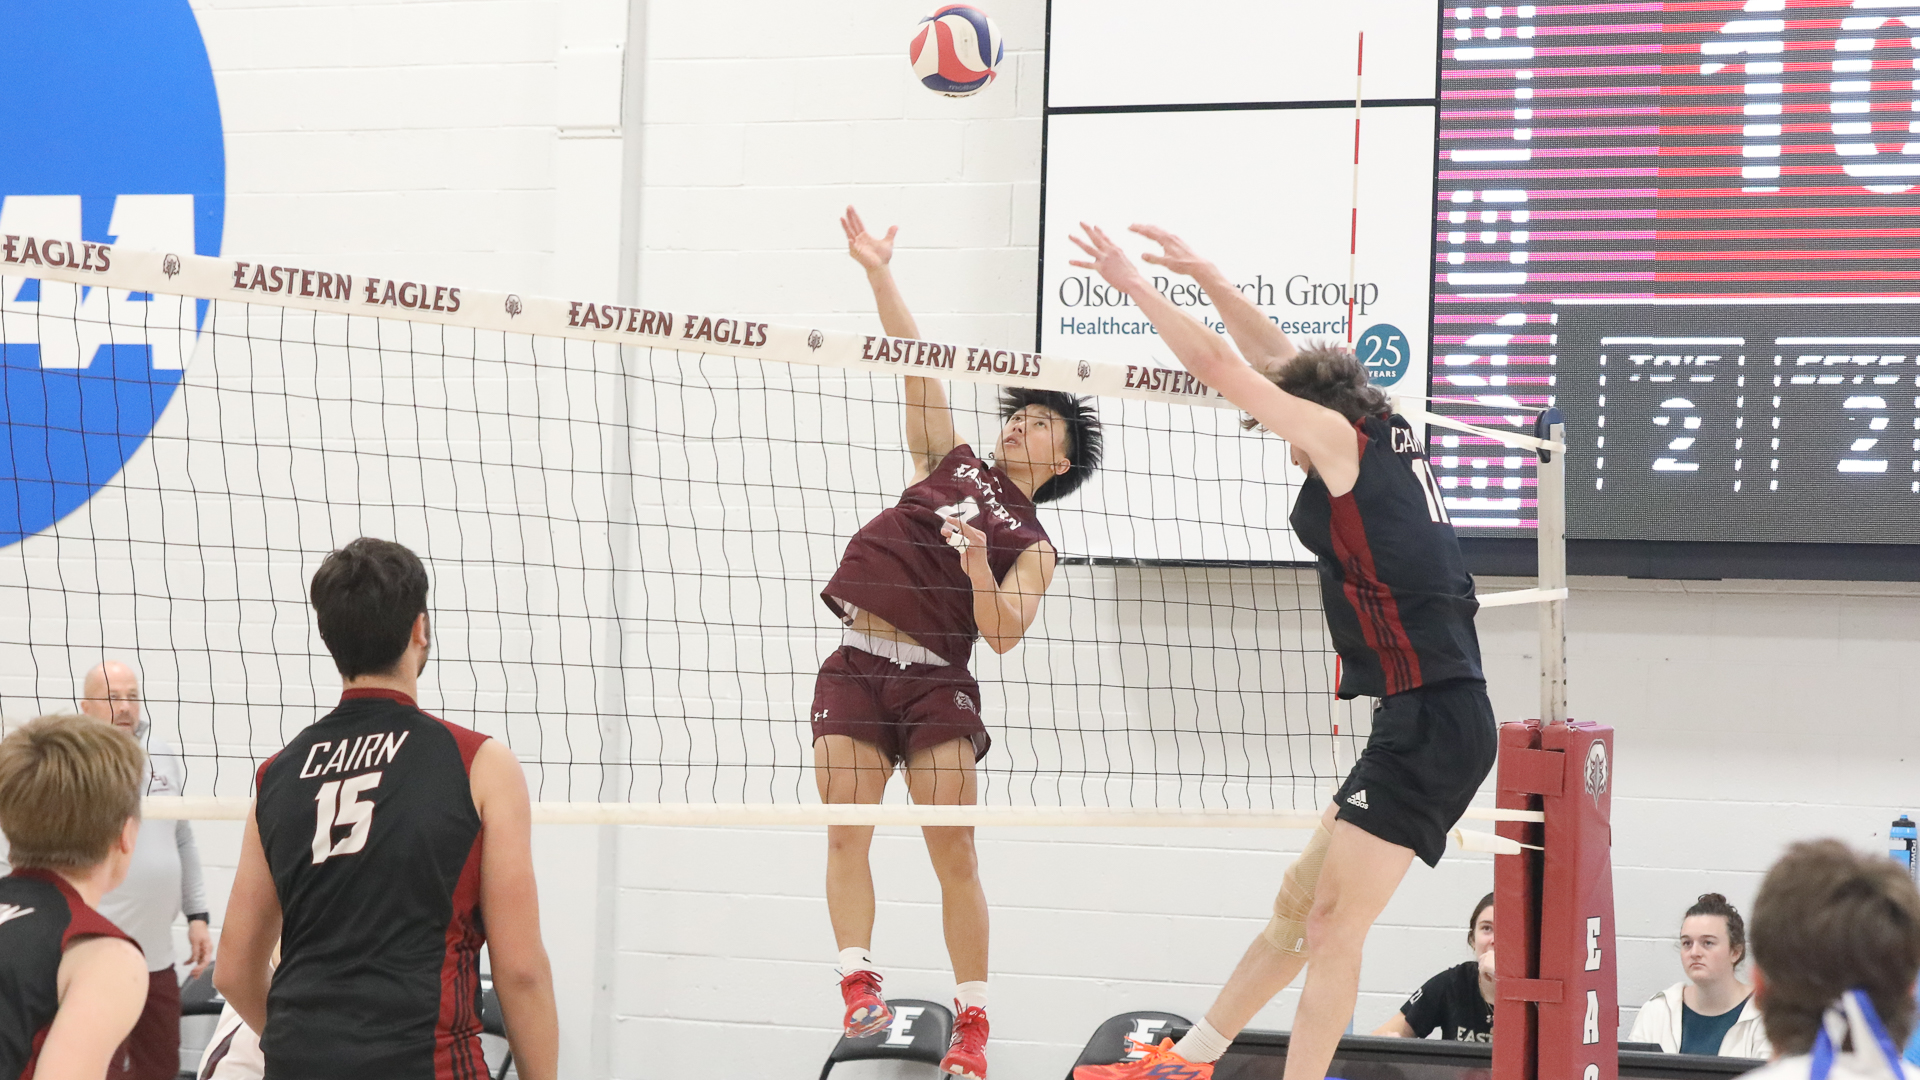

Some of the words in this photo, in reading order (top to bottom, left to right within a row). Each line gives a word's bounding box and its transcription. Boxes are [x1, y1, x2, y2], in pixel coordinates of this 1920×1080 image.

[2, 234, 111, 273] EAGLES
[233, 261, 352, 301] EASTERN
[364, 277, 461, 313] EAGLES
[1285, 274, 1379, 316] Group
[568, 300, 674, 337] EASTERN
[682, 314, 768, 348] EAGLES
[1060, 316, 1159, 335] Healthcare
[861, 335, 957, 370] EASTERN
[966, 346, 1042, 377] EAGLES
[1363, 334, 1402, 368] 25
[1367, 370, 1397, 379] YEARS
[1652, 396, 1701, 472] 2
[1837, 395, 1890, 473] 2
[299, 730, 409, 779] CAIRN
[311, 771, 383, 865] 15
[1346, 797, 1370, 810] adidas
